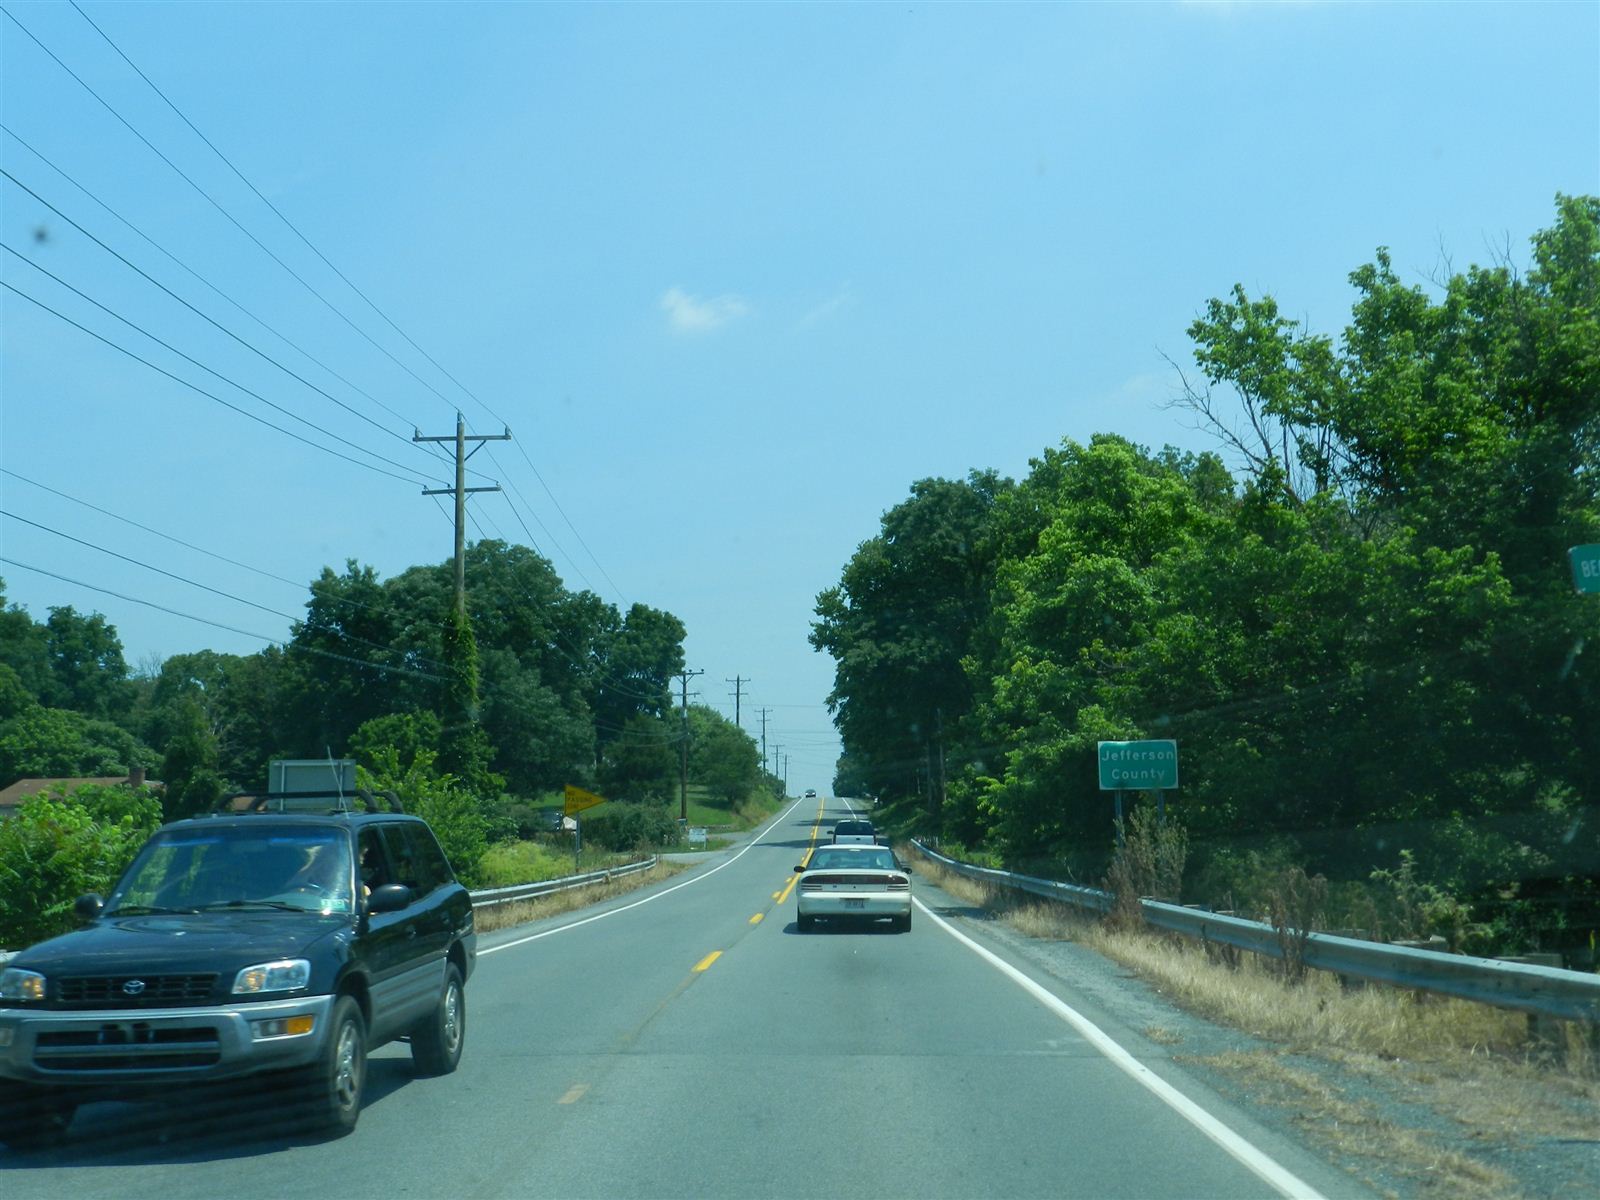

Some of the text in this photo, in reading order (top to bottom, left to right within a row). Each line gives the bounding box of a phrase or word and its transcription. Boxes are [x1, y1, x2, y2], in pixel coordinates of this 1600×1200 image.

[1581, 560, 1600, 577] BE
[1102, 750, 1174, 761] Jefferson
[1112, 768, 1166, 780] County
